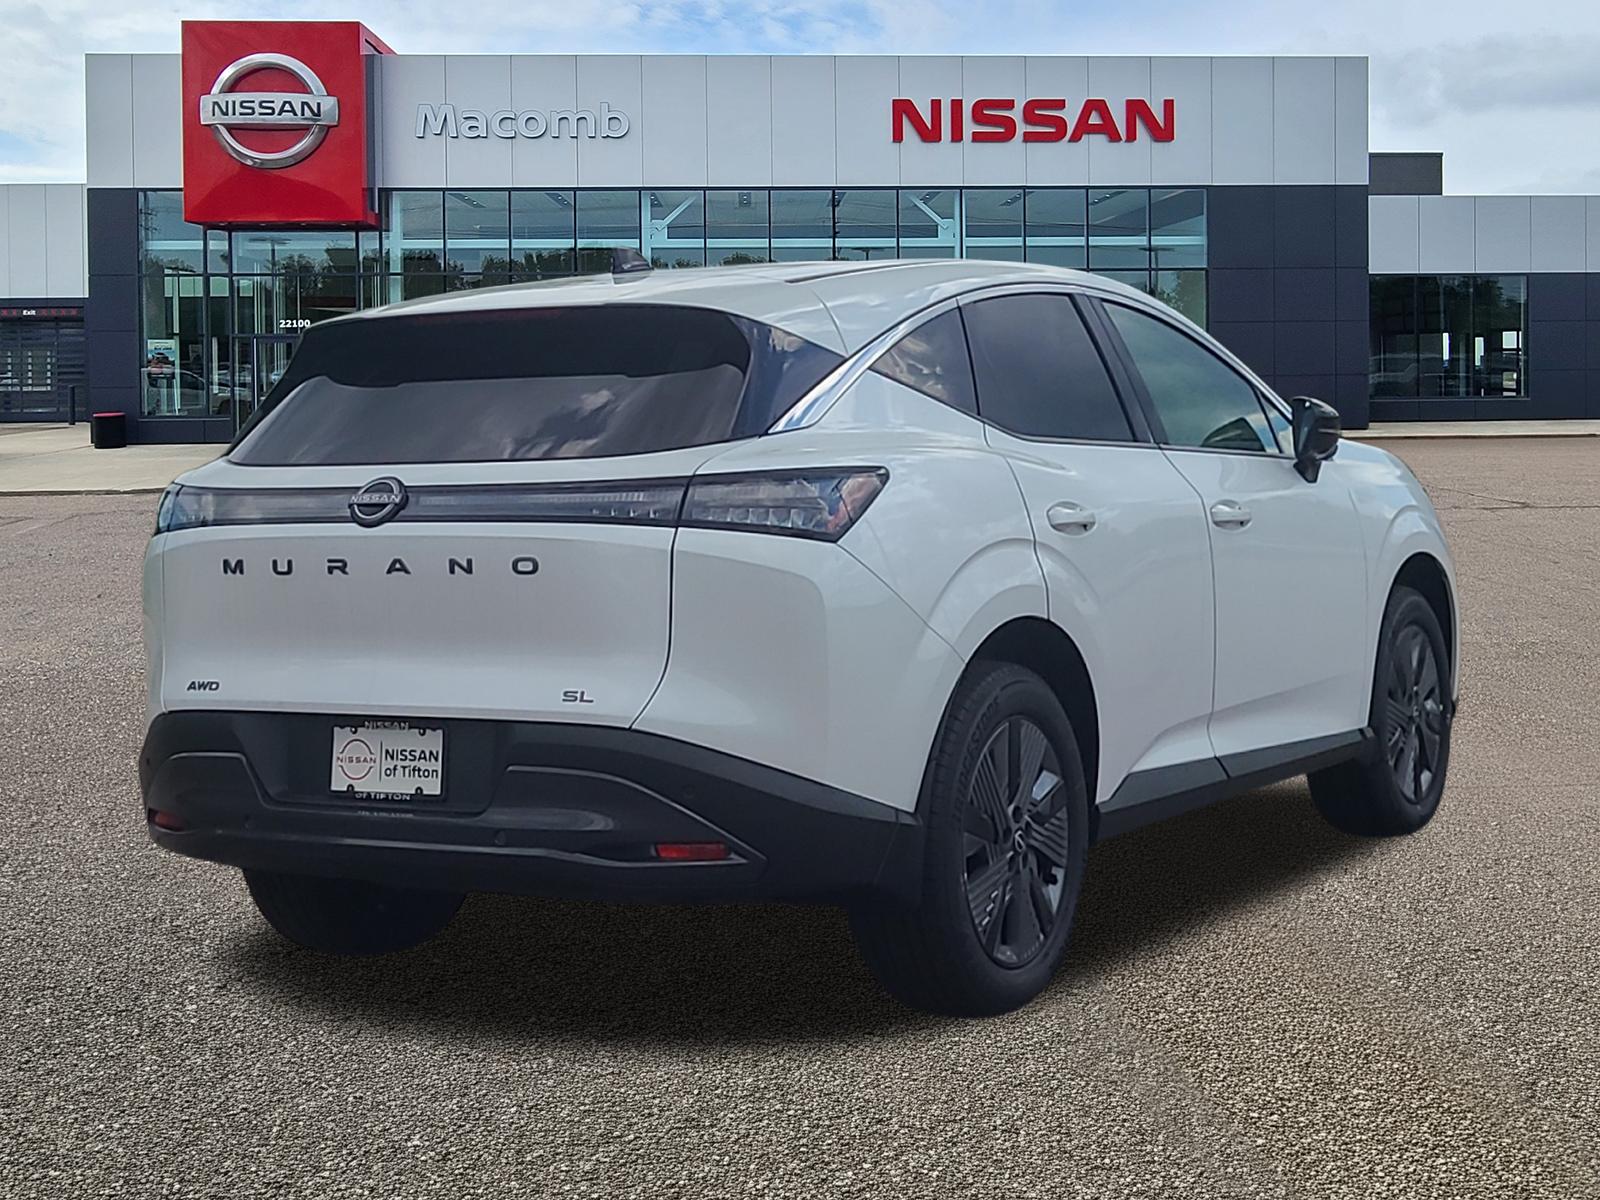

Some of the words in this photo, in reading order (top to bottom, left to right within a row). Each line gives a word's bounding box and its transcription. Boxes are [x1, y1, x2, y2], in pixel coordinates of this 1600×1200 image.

[211, 93, 322, 118] NISSAN
[415, 102, 629, 140] Macomb
[892, 98, 1175, 143] NISSAN
[279, 319, 311, 328] 22100
[350, 494, 402, 503] NISSAN
[222, 557, 539, 575] MURANO
[186, 680, 220, 692] AWD
[562, 690, 594, 704] SL
[364, 721, 409, 730] NISSAN
[336, 756, 376, 764] NISSAN
[385, 749, 439, 763] NISSAN
[384, 765, 398, 778] of
[401, 765, 438, 779] Tifton
